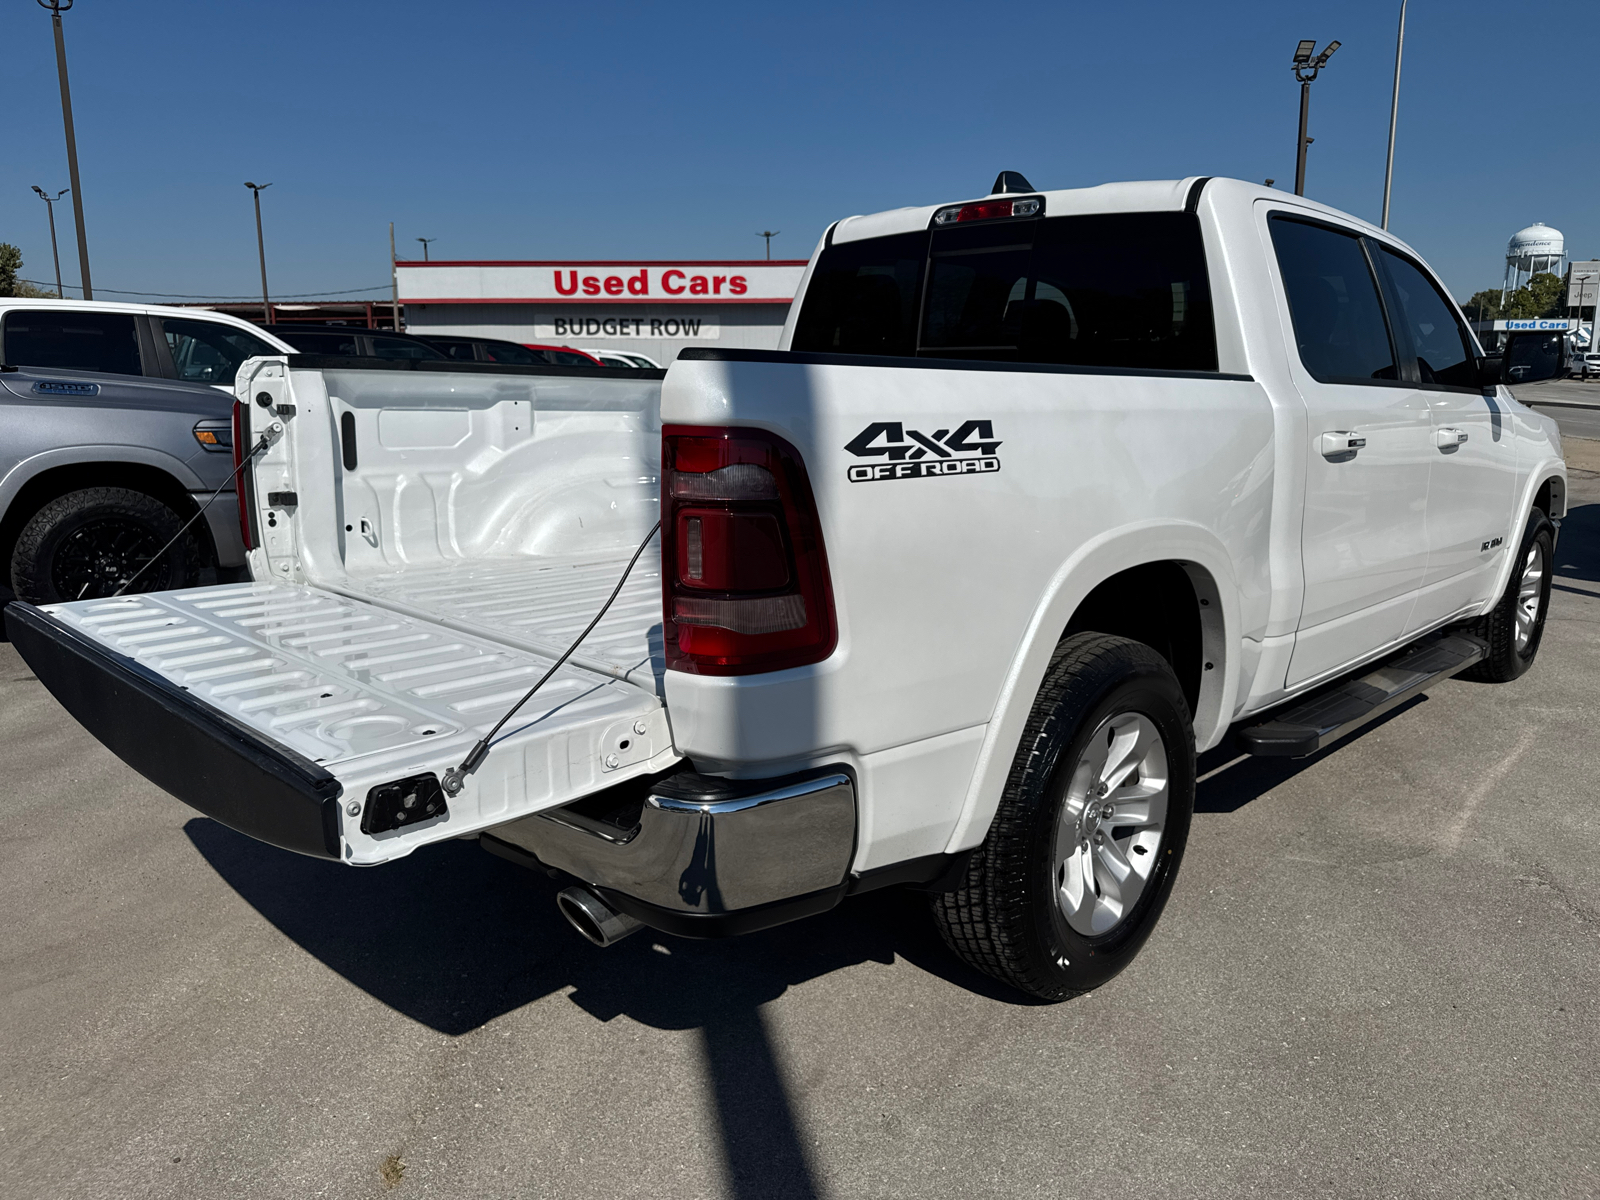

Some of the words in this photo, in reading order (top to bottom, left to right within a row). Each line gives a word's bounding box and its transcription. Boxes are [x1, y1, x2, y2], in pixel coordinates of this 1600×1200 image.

[554, 269, 649, 295] Used
[661, 270, 748, 295] Cars
[555, 318, 644, 336] BUDGET
[650, 318, 701, 336] ROW
[1505, 321, 1536, 330] Used
[1539, 321, 1568, 330] Cars
[850, 464, 915, 481] OFF
[920, 460, 999, 476] ROAD
